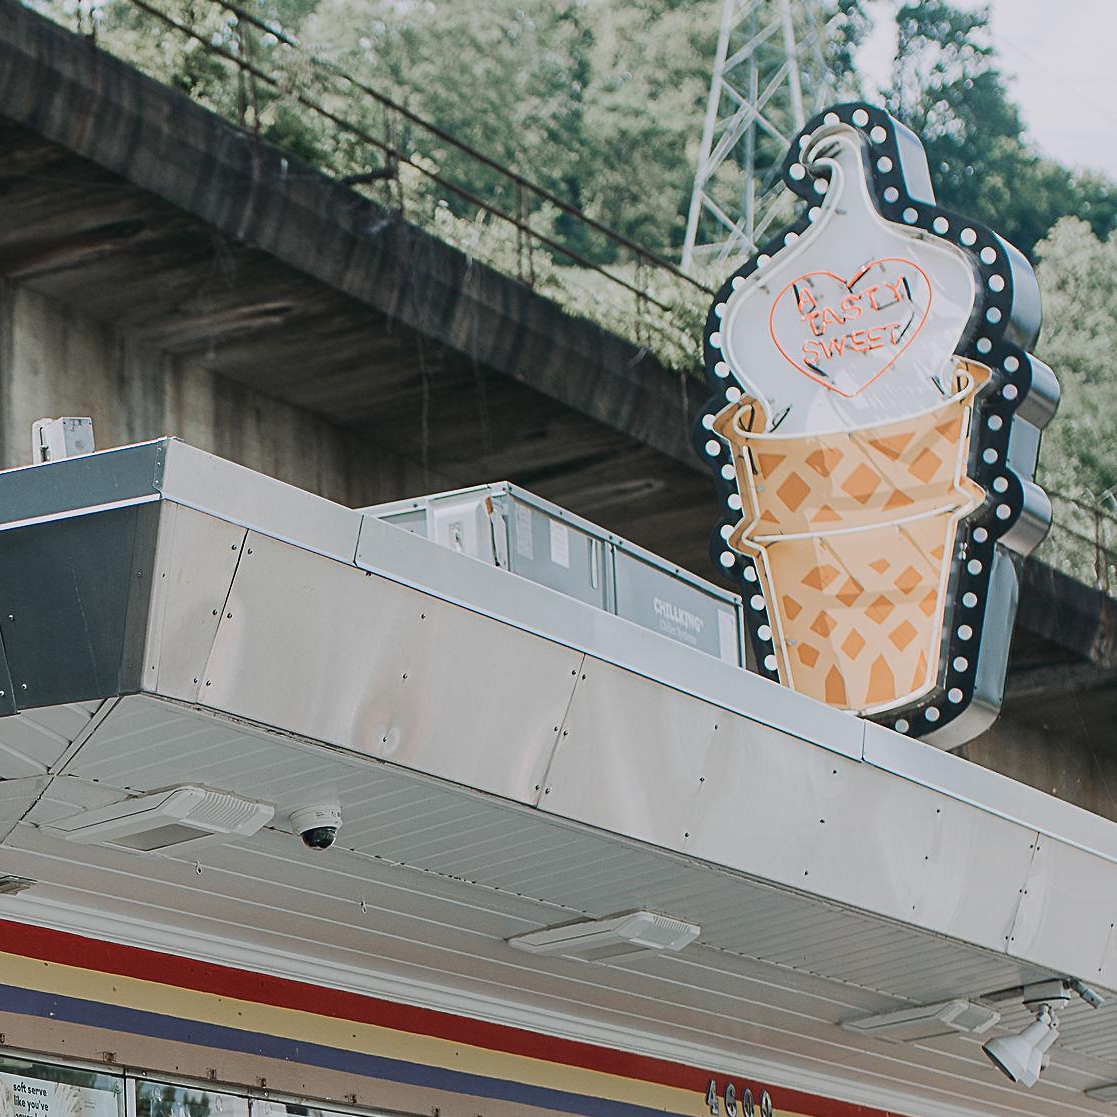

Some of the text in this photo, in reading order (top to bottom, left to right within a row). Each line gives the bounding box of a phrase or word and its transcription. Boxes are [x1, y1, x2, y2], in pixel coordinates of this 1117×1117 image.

[806, 274, 905, 336] TASTY
[802, 323, 901, 364] SWEET
[13, 1082, 47, 1097] soft serve
[14, 1095, 49, 1112] like you've
